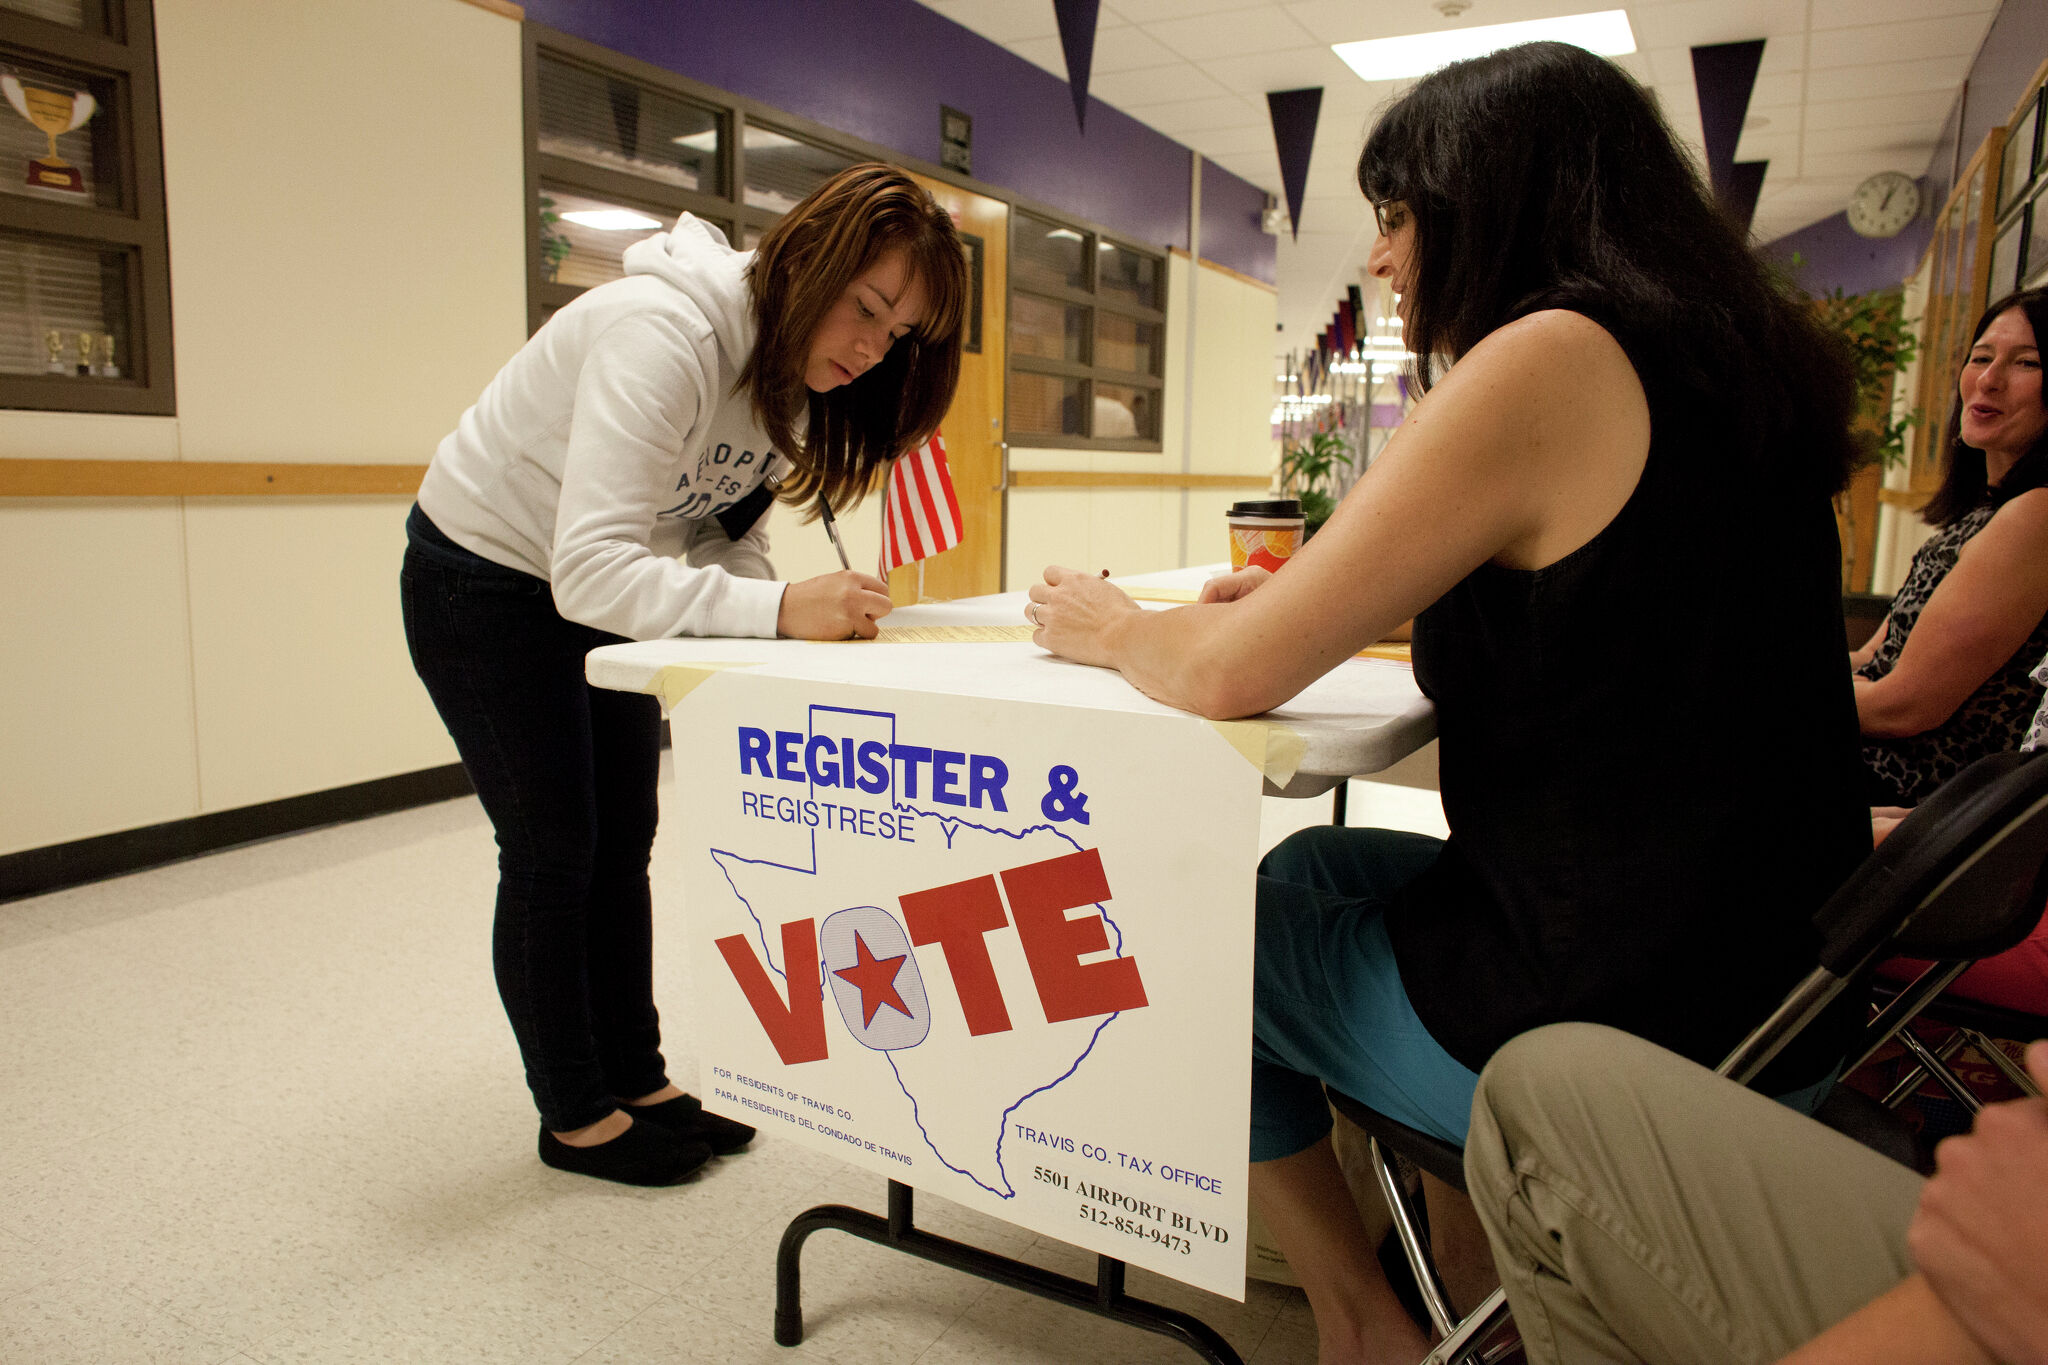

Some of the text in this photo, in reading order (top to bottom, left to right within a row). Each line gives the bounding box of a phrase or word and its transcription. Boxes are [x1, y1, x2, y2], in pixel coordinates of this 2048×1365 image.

[738, 726, 1090, 826] REGISTER &
[742, 791, 959, 849] REGISTRESE Y
[714, 847, 1149, 1066] VOTE
[713, 1067, 854, 1122] FOR RESIDENTS OF TRAVIS CO.
[715, 1087, 913, 1166] PARA RESIDENTES DEL CONDADO DE TRAVIS
[1015, 1124, 1223, 1195] TRAVIS CO. TAX OFFICE
[1033, 1166, 1229, 1244] 5501 AIRPORT BLVD
[1079, 1204, 1191, 1255] 512-854-9473
